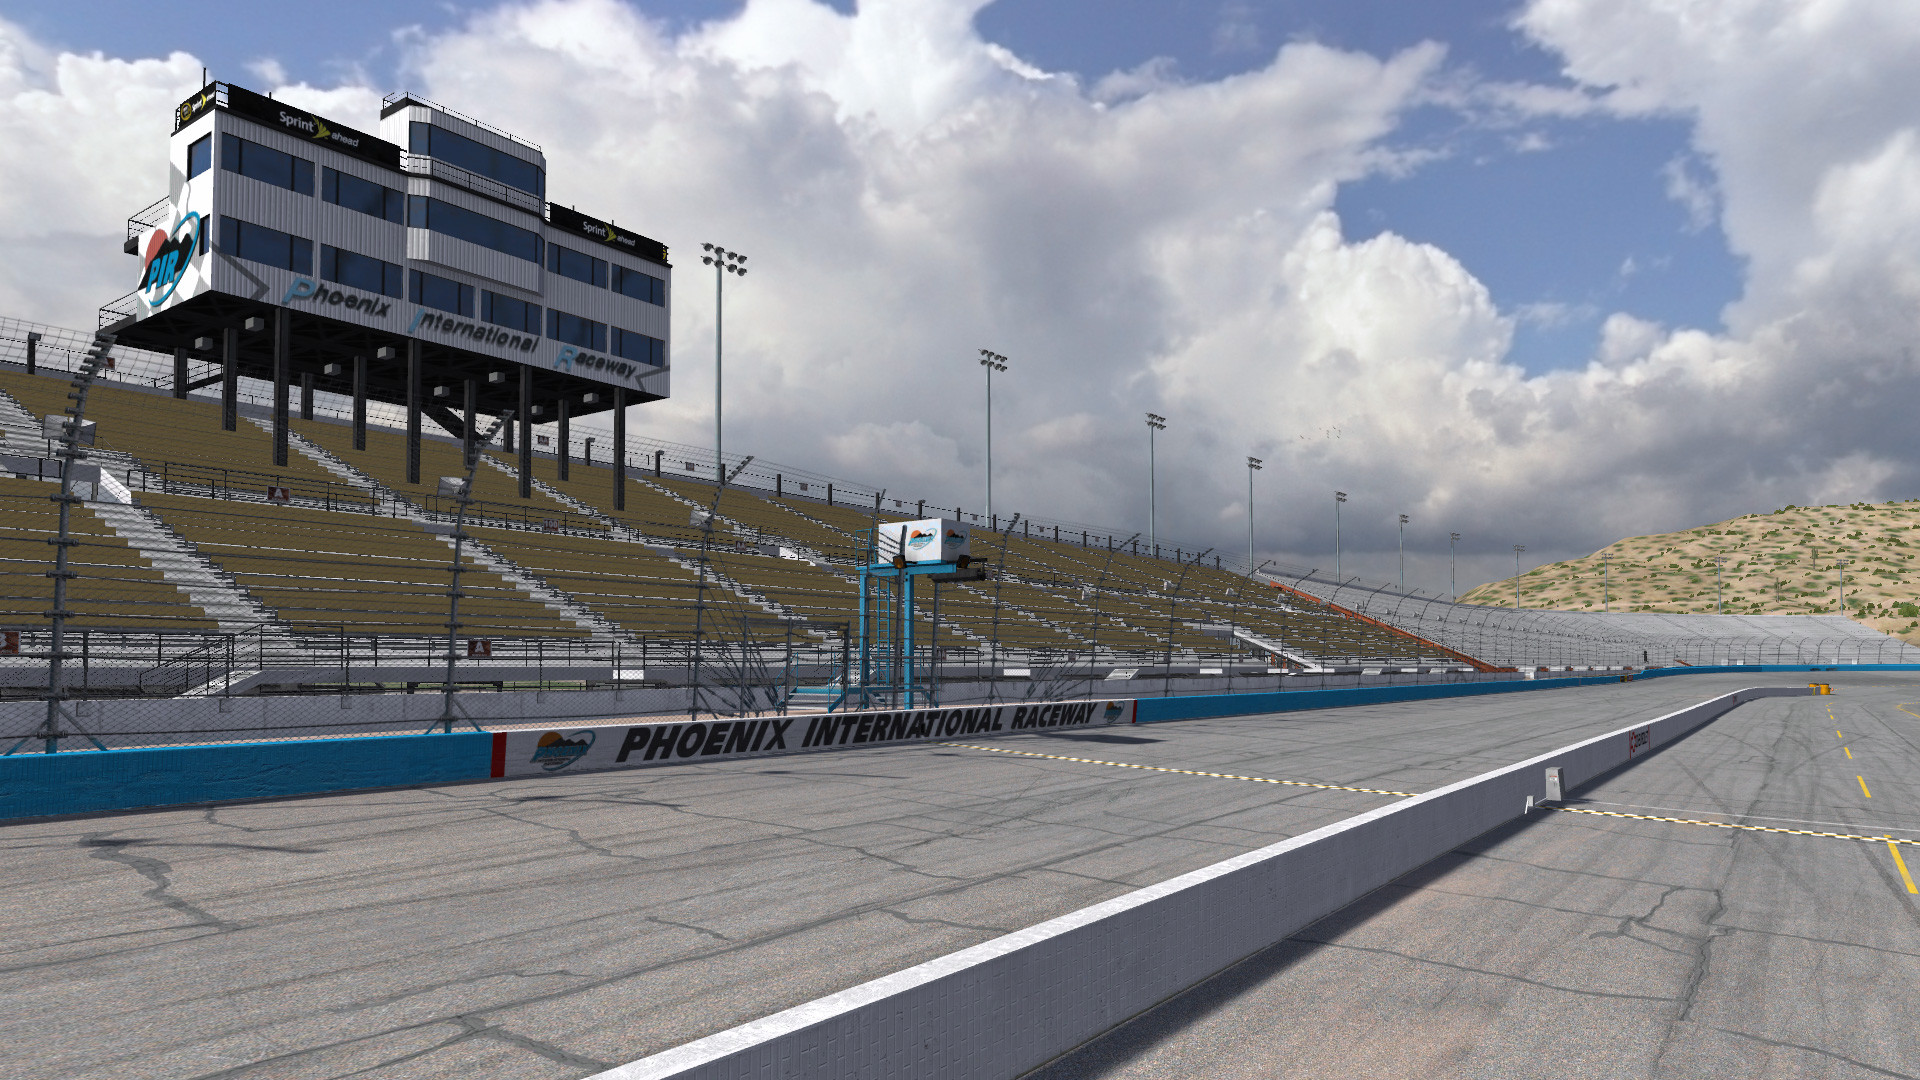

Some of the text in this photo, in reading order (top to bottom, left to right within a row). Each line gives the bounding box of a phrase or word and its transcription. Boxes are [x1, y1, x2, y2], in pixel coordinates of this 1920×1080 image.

[279, 111, 359, 147] Sprint ahead
[583, 221, 636, 247] Sprint ahead
[145, 249, 180, 295] PIR
[281, 277, 637, 379] Phoenix International Raceway
[474, 641, 485, 653] A
[615, 702, 1098, 763] PHOENIX INTERNATIONAL RACEWAY
